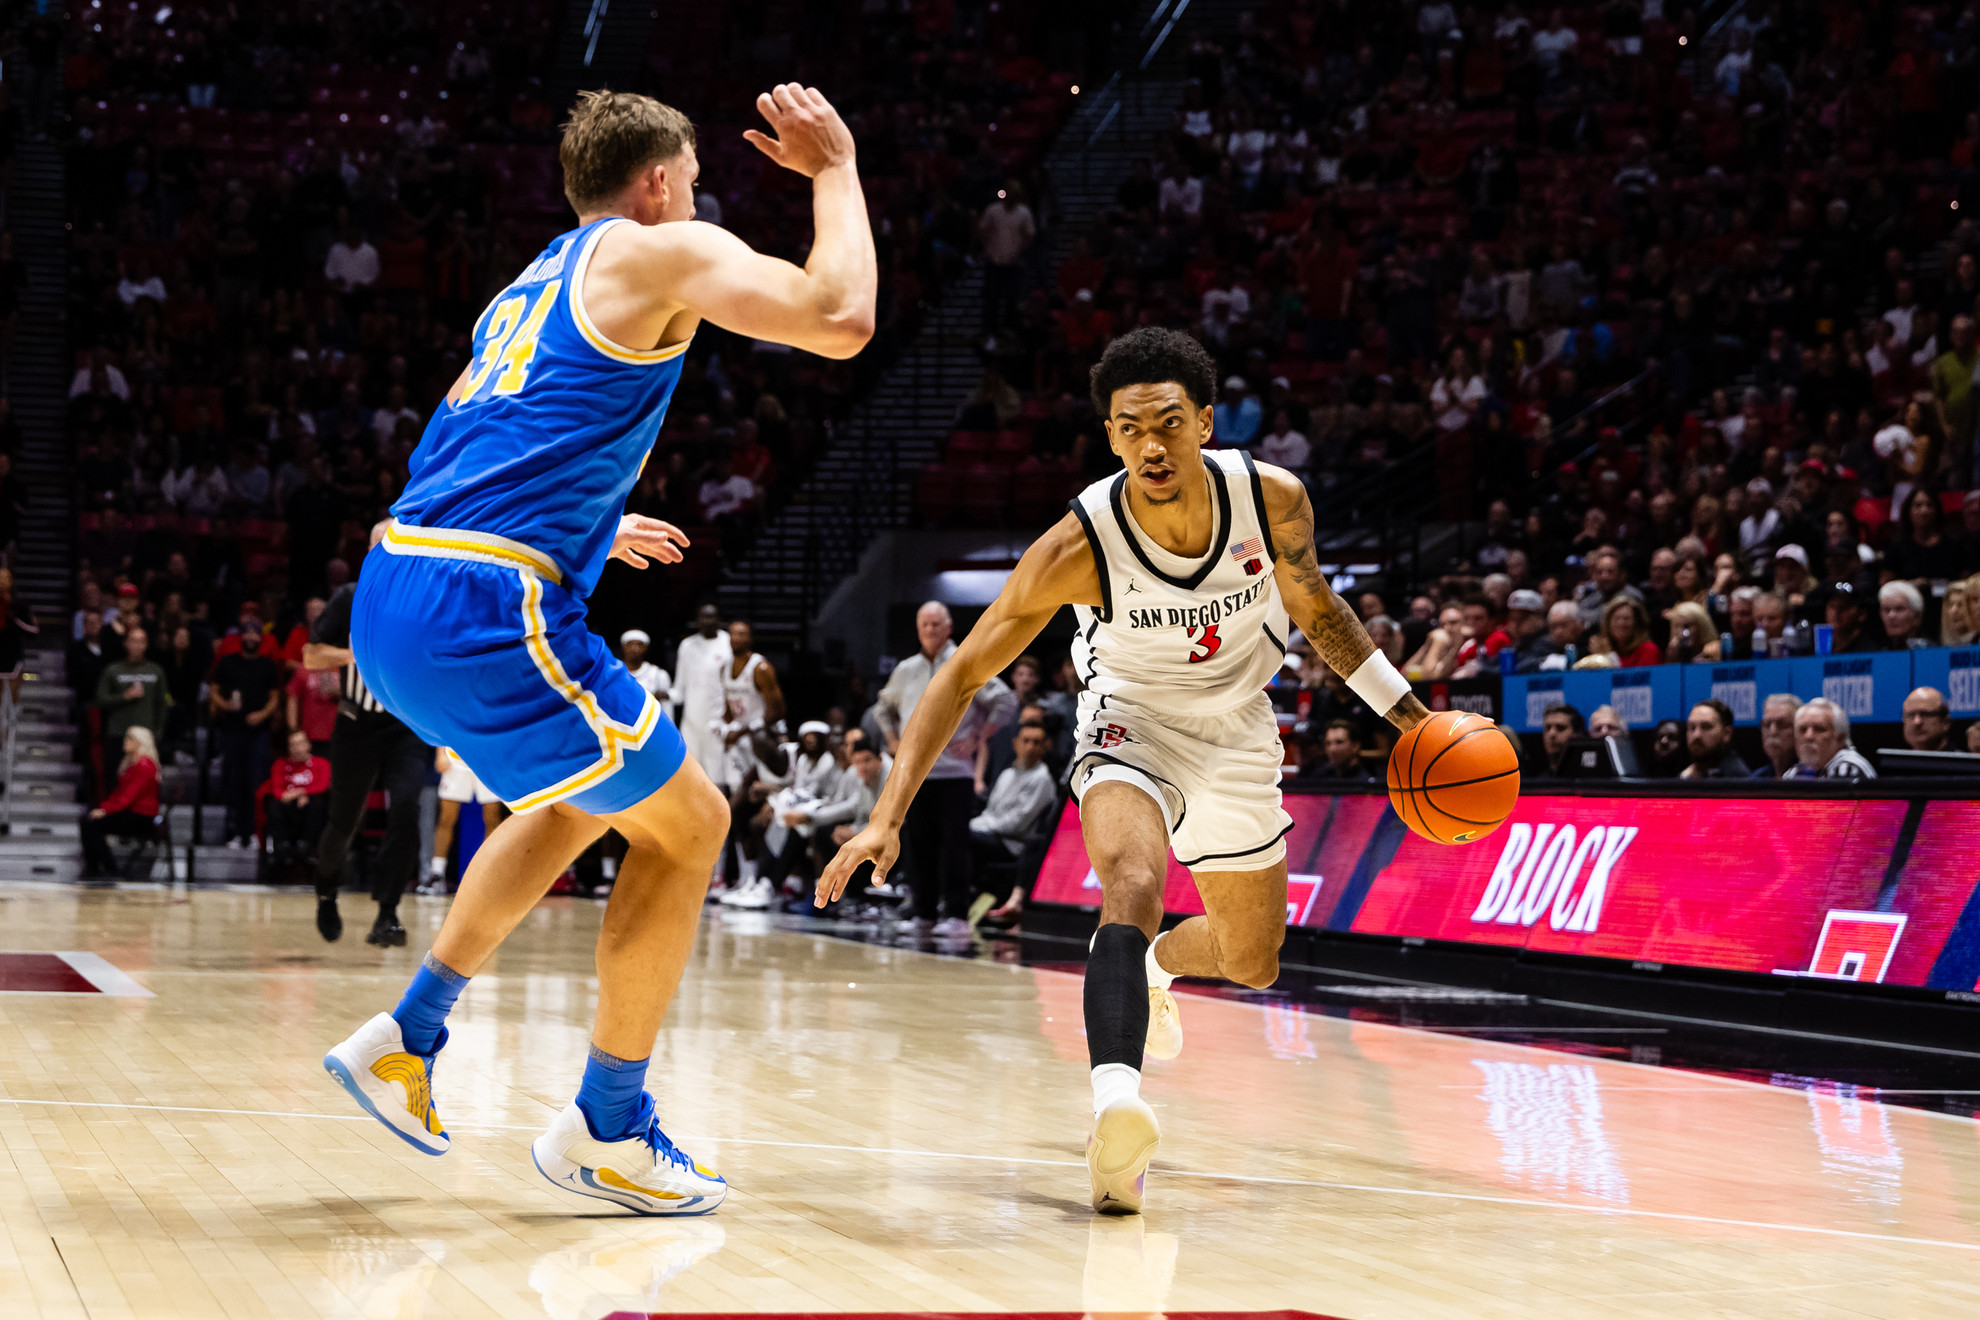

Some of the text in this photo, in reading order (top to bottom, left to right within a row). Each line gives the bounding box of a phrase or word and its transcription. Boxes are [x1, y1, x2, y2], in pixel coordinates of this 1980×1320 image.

[456, 279, 562, 408] 34
[1129, 608, 1163, 629] SAN
[1166, 599, 1221, 628] DIEGO
[1187, 624, 1222, 664] 3
[1470, 822, 1639, 934] BLOCK
